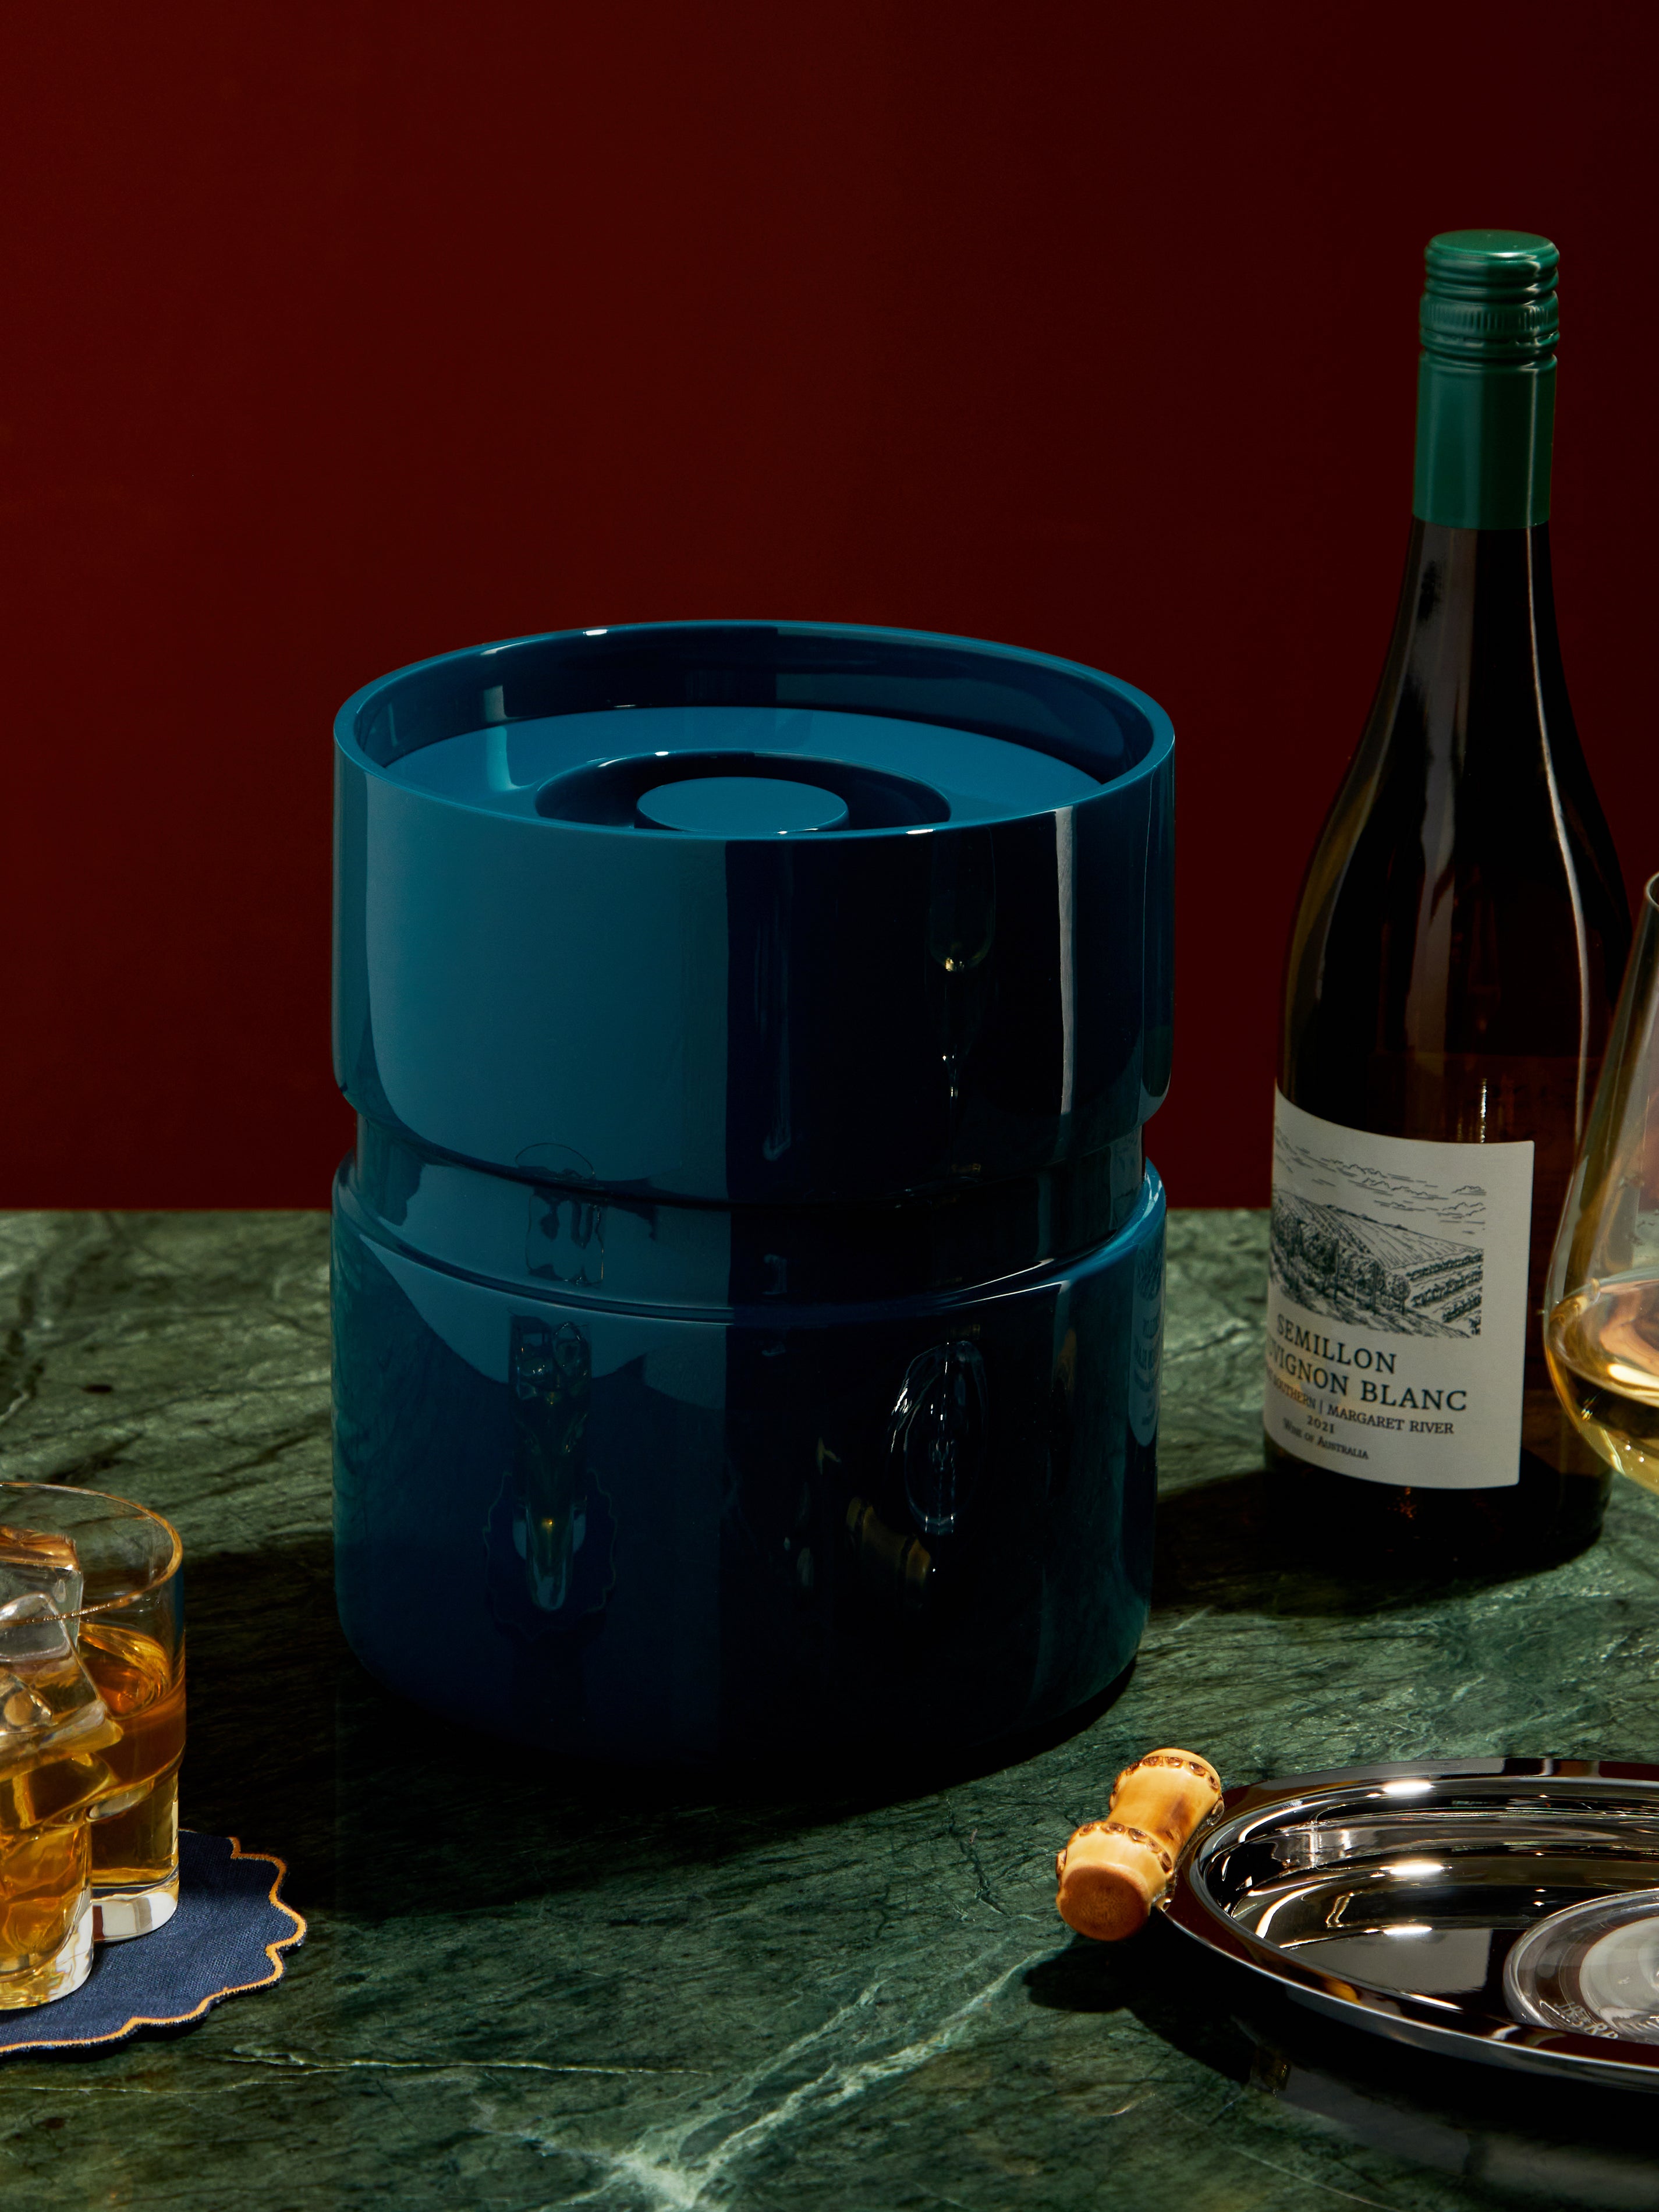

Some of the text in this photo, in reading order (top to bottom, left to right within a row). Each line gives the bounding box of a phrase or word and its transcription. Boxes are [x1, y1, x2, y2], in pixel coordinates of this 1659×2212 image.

[1277, 1313, 1397, 1374] SEMILLON
[1360, 1380, 1467, 1412] BLANC
[1307, 1415, 1335, 1434] 2021
[1327, 1403, 1405, 1431] MARGARET
[1409, 1420, 1455, 1434] RIVER
